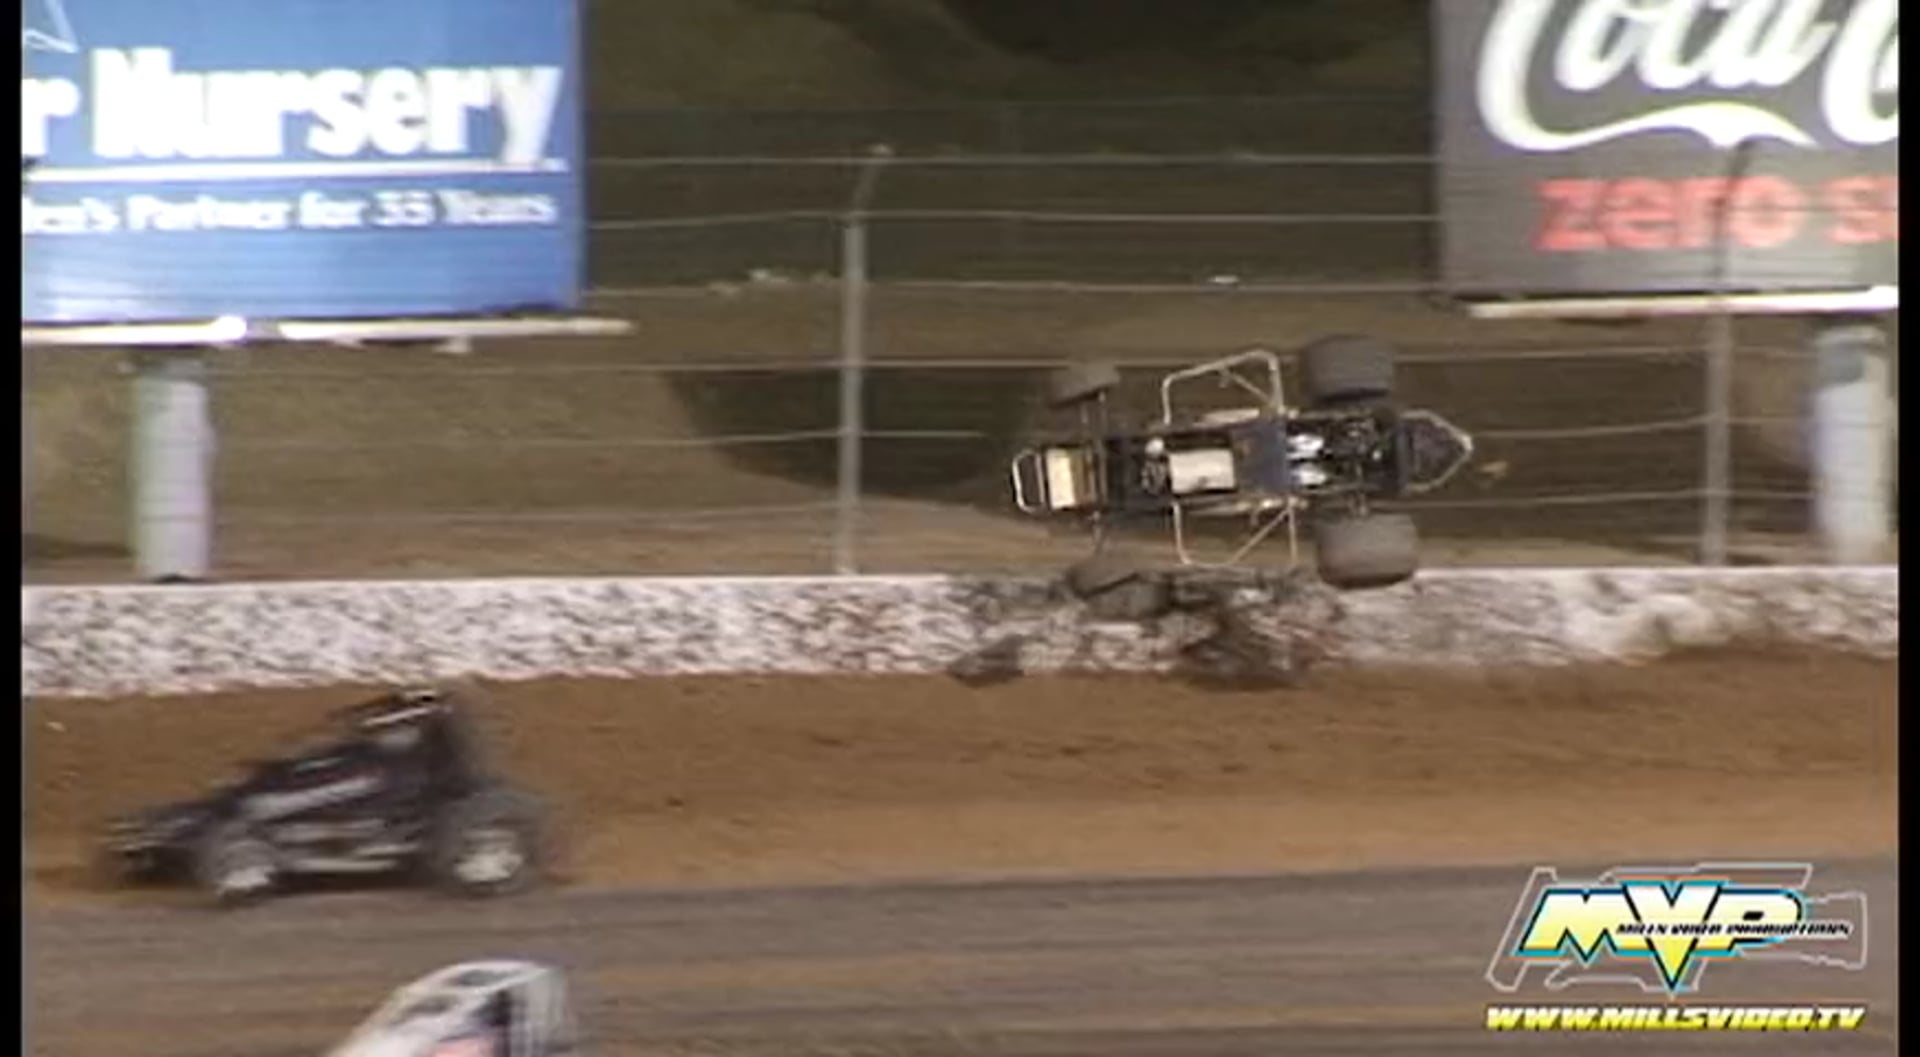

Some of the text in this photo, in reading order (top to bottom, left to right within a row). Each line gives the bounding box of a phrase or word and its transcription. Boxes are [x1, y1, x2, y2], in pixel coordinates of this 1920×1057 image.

[92, 47, 562, 168] Nursery
[126, 193, 290, 231] Partner
[299, 190, 366, 229] for
[436, 188, 558, 226] Years
[1534, 176, 1804, 252] zero
